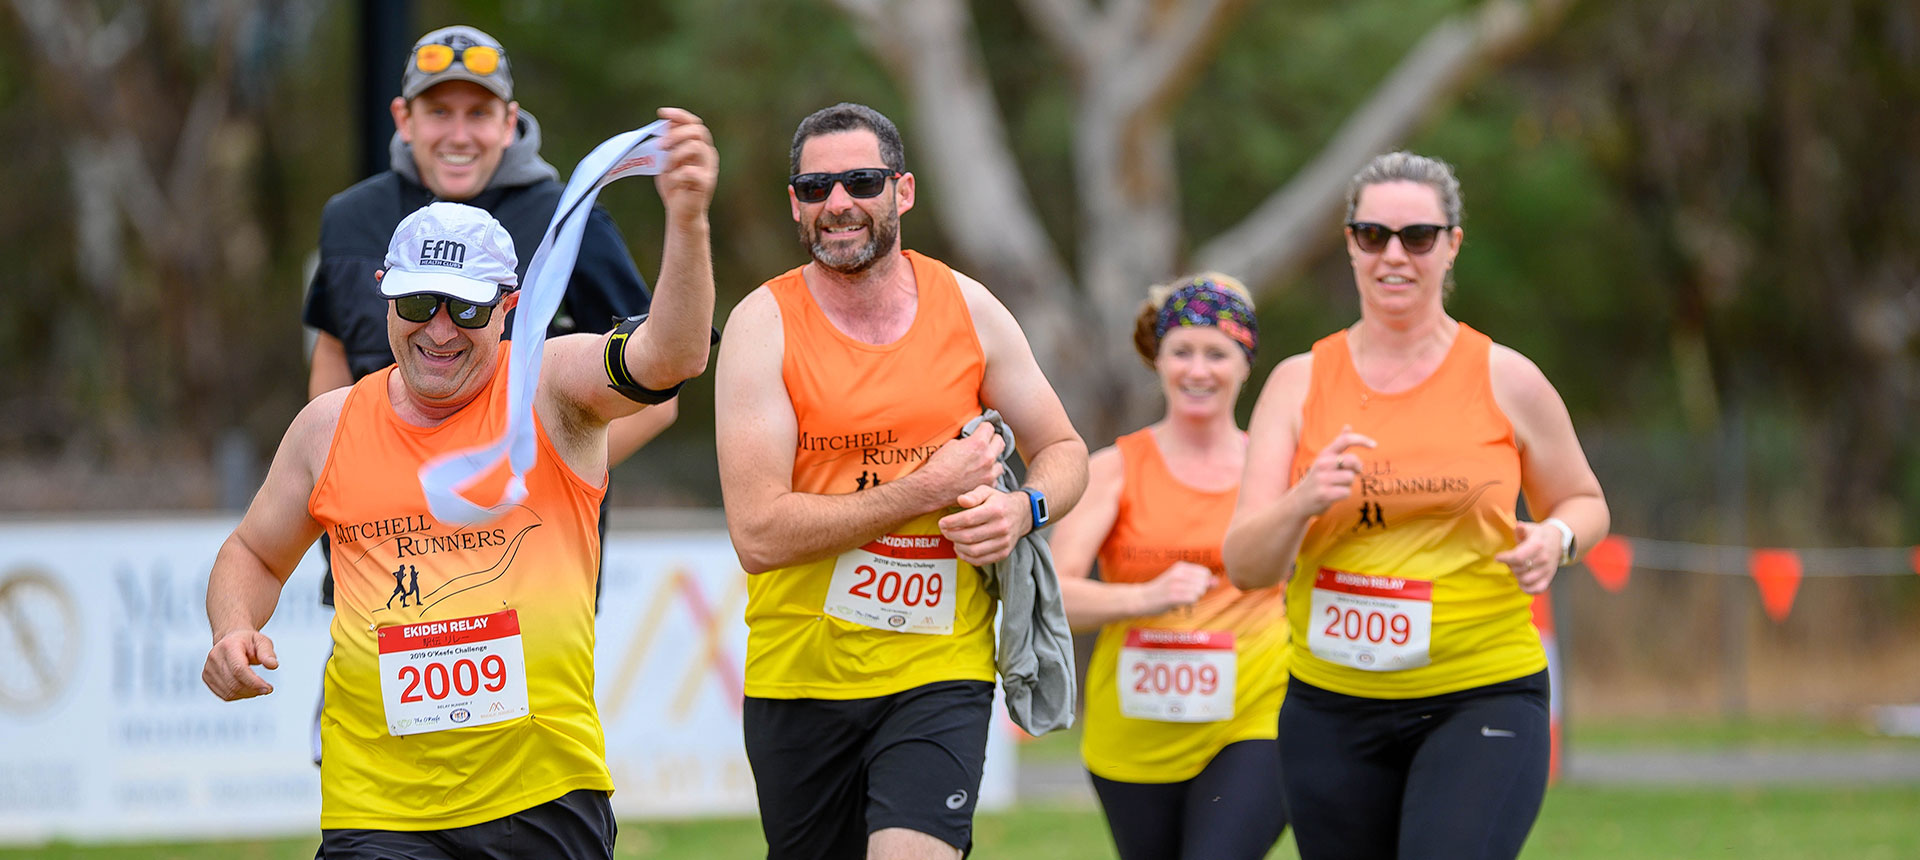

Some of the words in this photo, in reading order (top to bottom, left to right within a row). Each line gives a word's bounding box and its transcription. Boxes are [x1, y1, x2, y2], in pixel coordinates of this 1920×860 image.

[800, 430, 899, 451] MITCHELL
[1360, 475, 1469, 498] RUNNERS
[335, 514, 432, 545] MITCHELL
[394, 528, 506, 559] RUNNERS
[914, 537, 941, 549] RELAY
[849, 565, 943, 608] 2009
[403, 622, 447, 638] EKIDEN
[449, 617, 489, 633] RELAY
[1324, 605, 1411, 646] 2009
[410, 652, 426, 660] 2019
[427, 649, 454, 658] O'Keefe
[454, 645, 487, 655] Challenge
[397, 654, 507, 704] 2009
[1132, 662, 1219, 696] 2009
